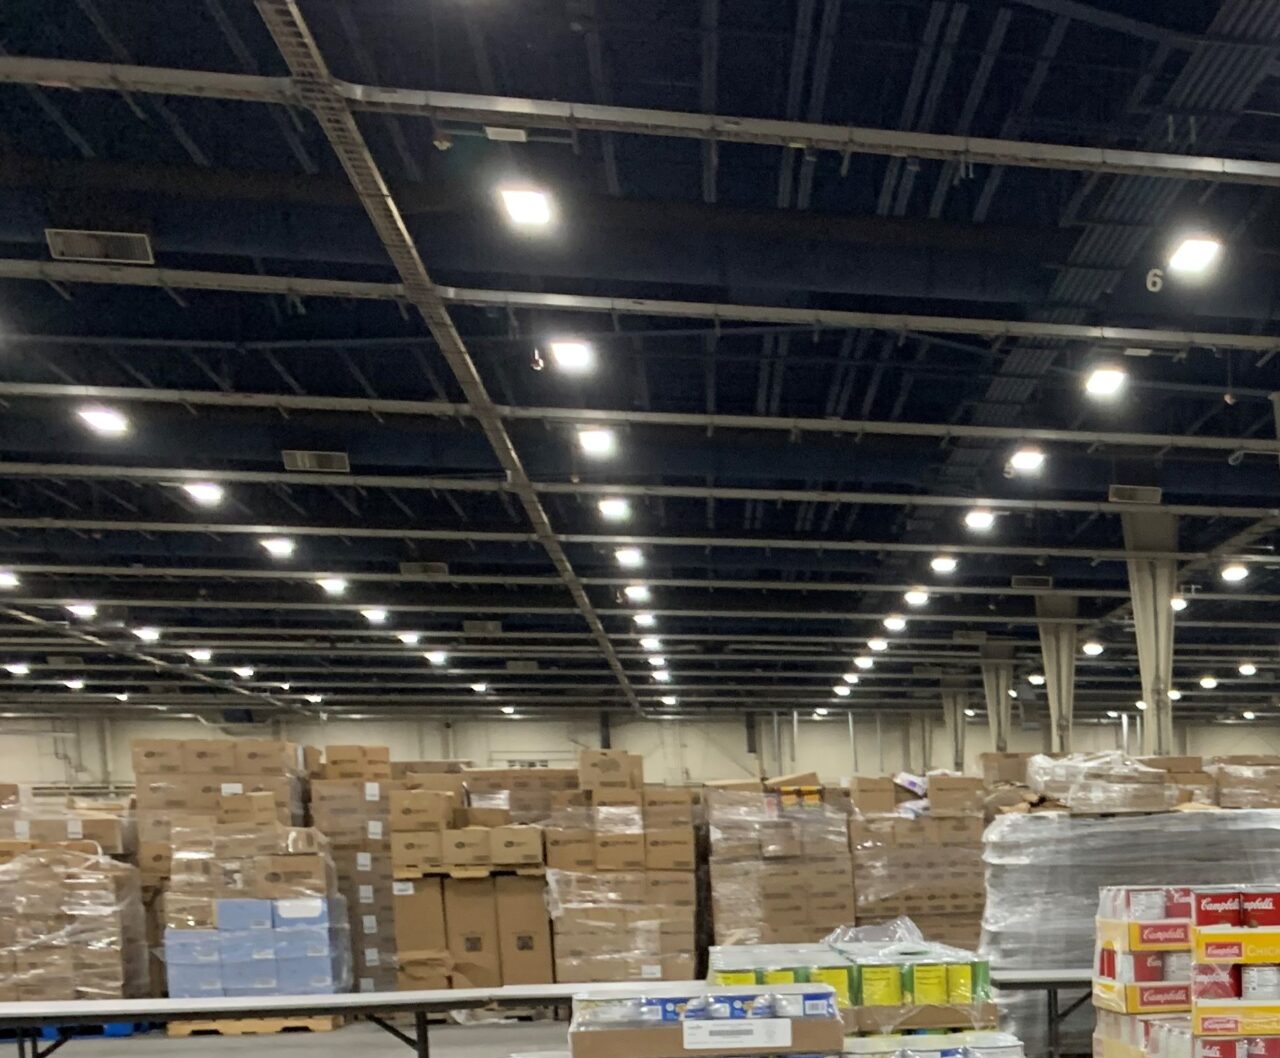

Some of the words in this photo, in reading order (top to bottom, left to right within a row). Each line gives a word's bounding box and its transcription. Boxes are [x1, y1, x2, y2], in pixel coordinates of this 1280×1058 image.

[1146, 268, 1163, 292] 6
[1201, 896, 1240, 912] Campbell
[1243, 895, 1276, 910] mpbell's
[1143, 926, 1186, 941] Campbell's
[1142, 989, 1187, 1003] Campbell's
